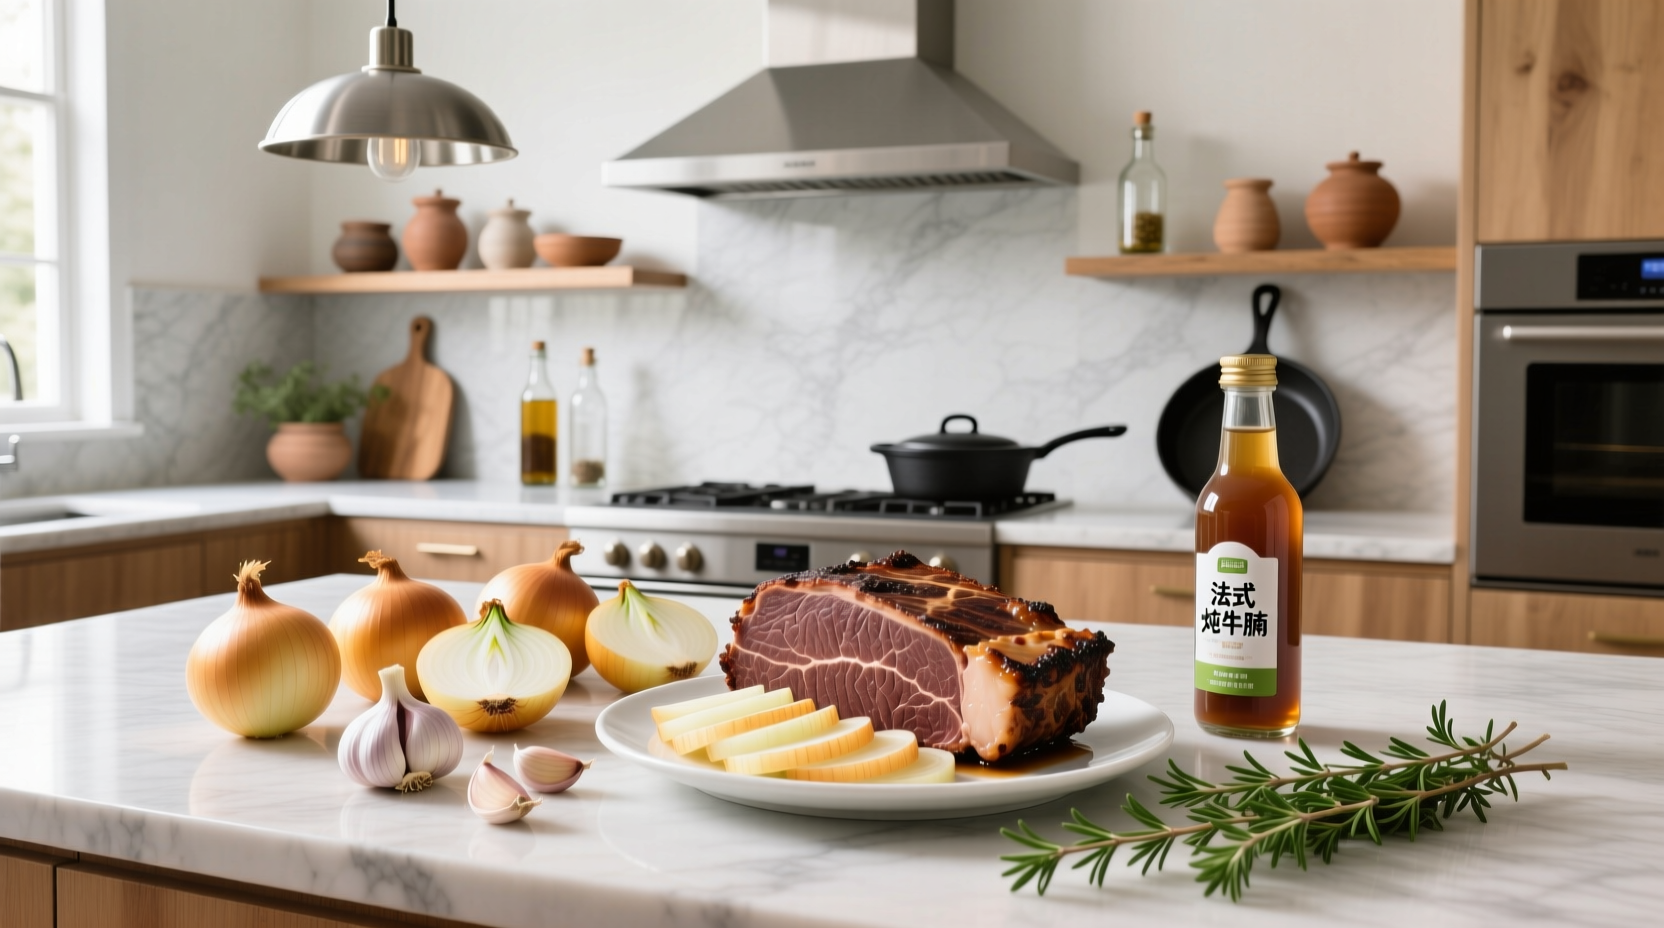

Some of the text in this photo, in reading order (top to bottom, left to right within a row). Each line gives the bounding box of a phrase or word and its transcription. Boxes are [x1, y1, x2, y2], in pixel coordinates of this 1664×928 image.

[1211, 581, 1256, 608] 法式
[1201, 608, 1268, 637] 炖牛腩
